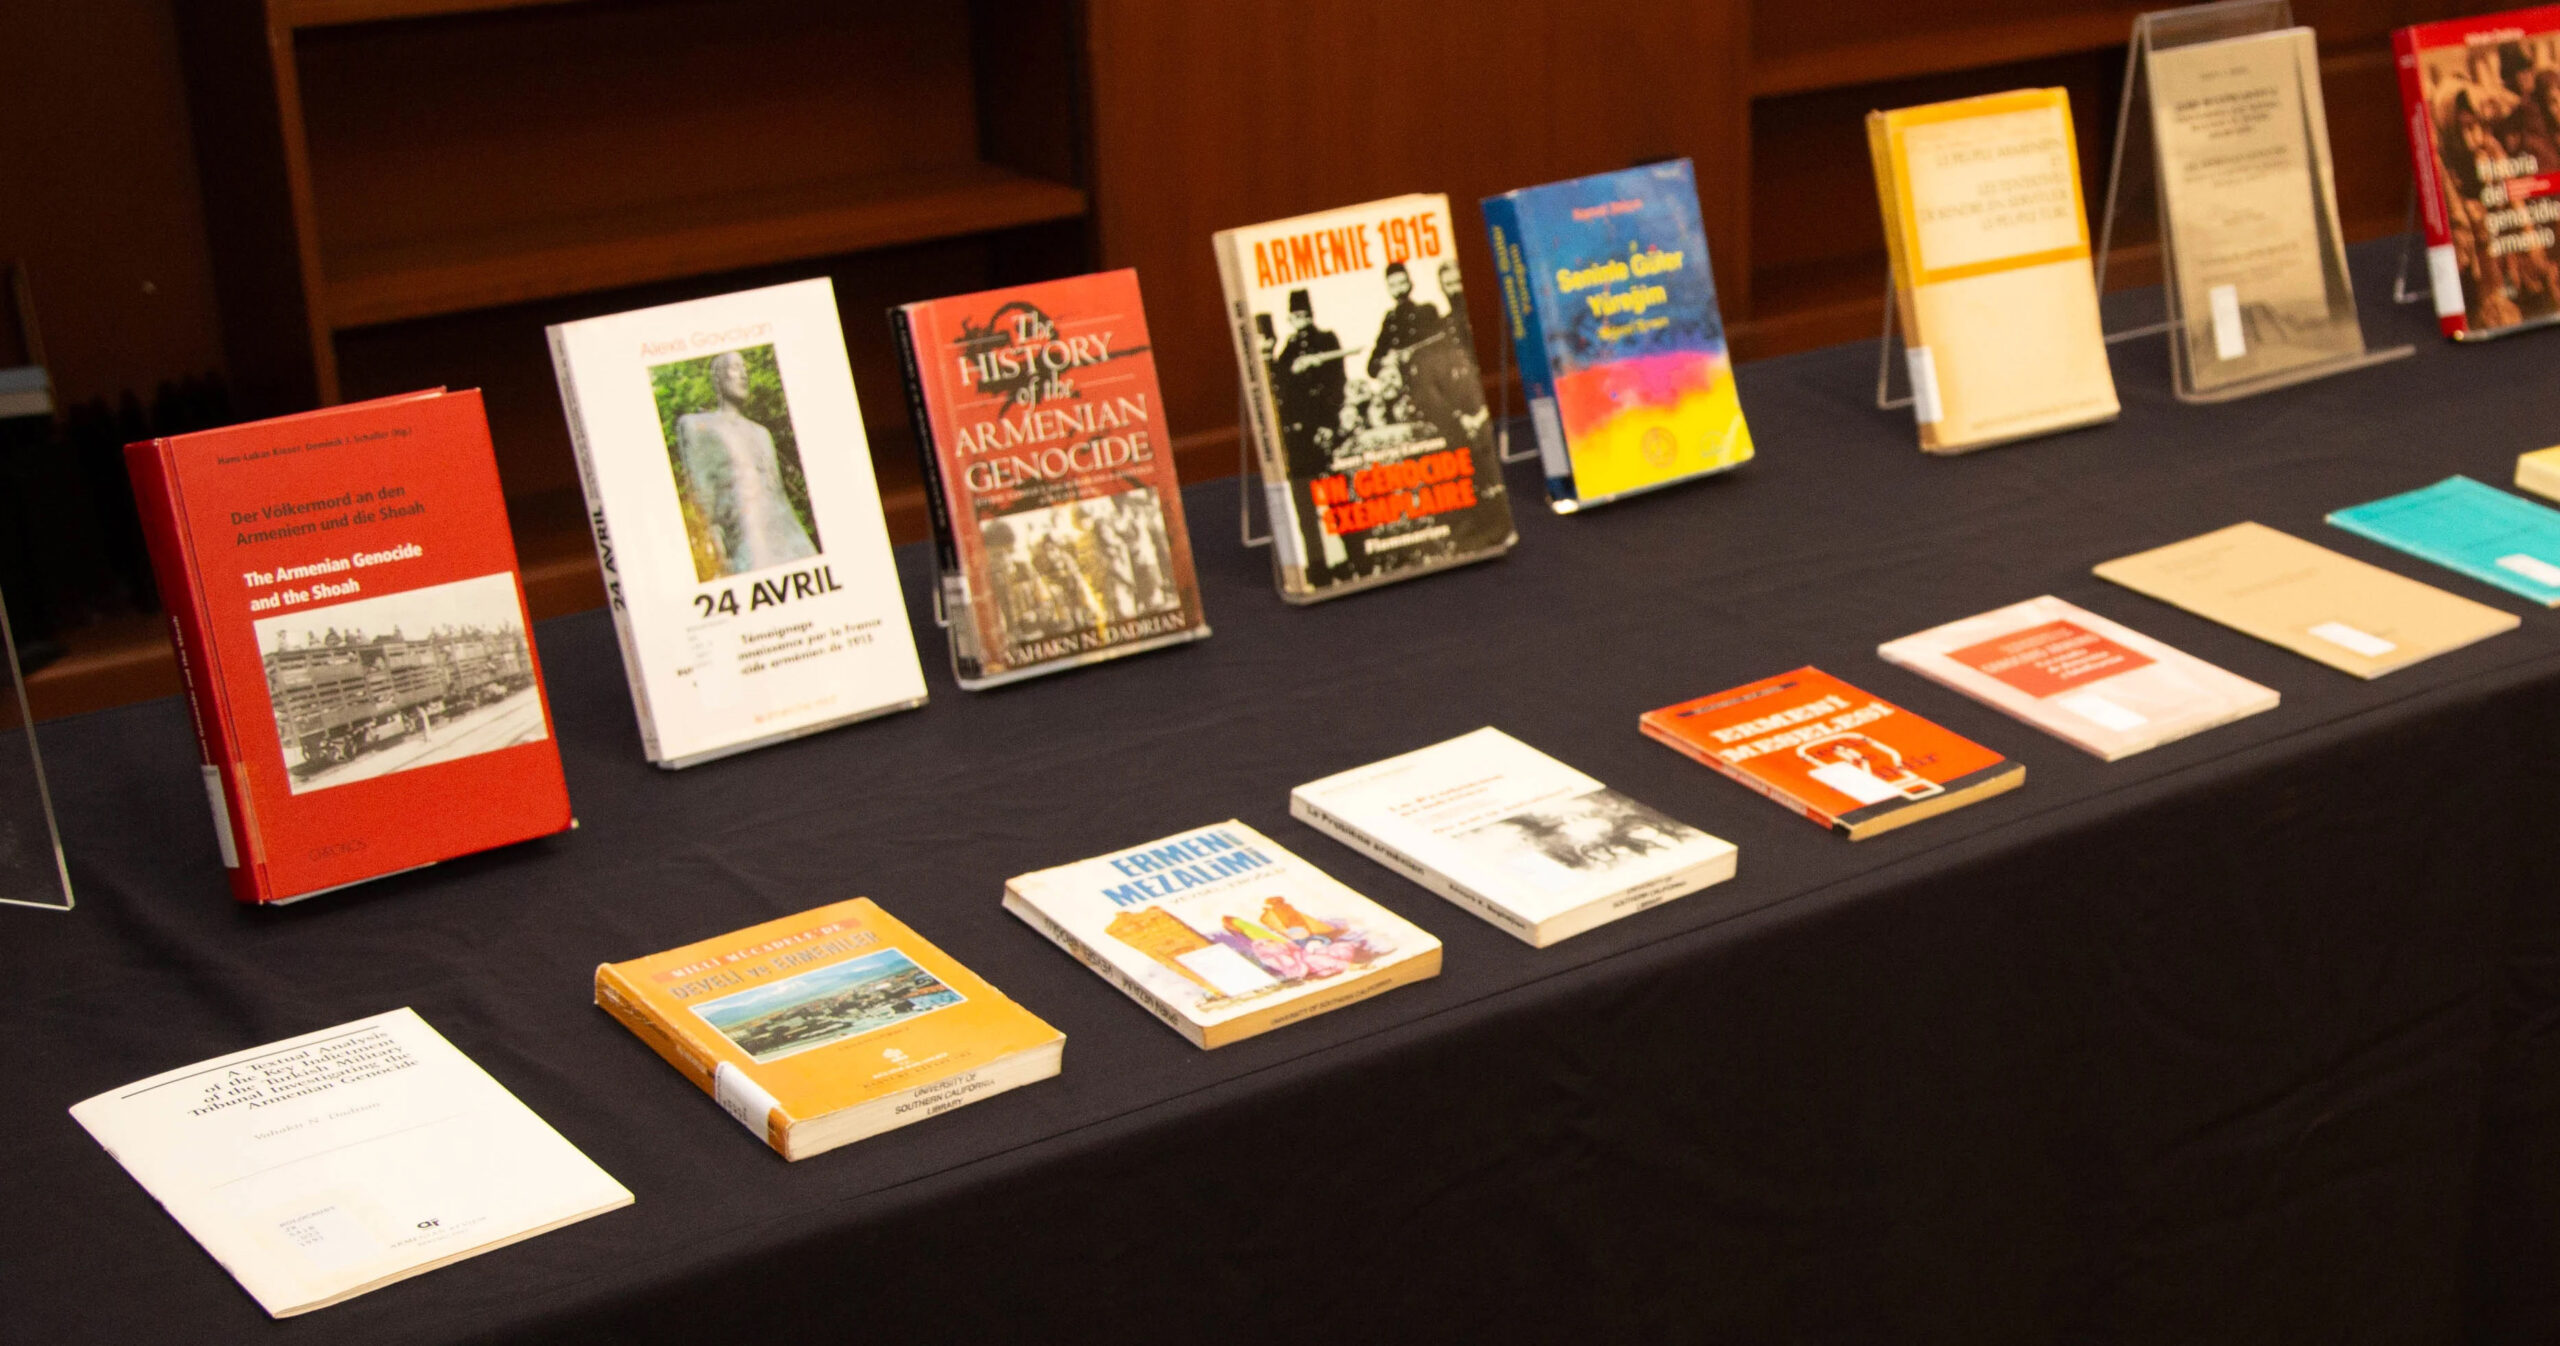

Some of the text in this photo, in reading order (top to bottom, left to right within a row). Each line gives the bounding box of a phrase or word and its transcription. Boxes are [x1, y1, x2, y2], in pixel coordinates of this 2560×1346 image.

[1254, 211, 1442, 289] ARMENIE 1915
[2489, 226, 2555, 258] armenio
[1012, 310, 1055, 344] The
[958, 331, 1114, 387] HISTORY
[1017, 372, 1075, 411] of the
[954, 393, 1150, 458] ARMENIAN
[963, 430, 1155, 492] GENOCIDE
[230, 485, 406, 526] Der Völkermord an den
[235, 501, 426, 547] Armeniern und die Shoah
[243, 542, 424, 588] The Armenian Genocide
[592, 504, 628, 611] 24 AVRIL
[249, 577, 361, 612] and the Shoah
[693, 564, 843, 618] 24 AVRIL
[738, 618, 882, 661] nnaissance par la France
[740, 620, 814, 645] Témoignage
[1005, 635, 1082, 668] VAHAKN
[1104, 611, 1187, 645] DADRIAN
[740, 662, 766, 676] cide
[829, 642, 843, 653] de
[1100, 845, 1275, 907] MEZALİMİ
[1111, 828, 1246, 879] ERMENİ
[745, 965, 773, 978] ve
[203, 1045, 404, 1105] of the Turkish Military
[204, 1038, 396, 1094] of the Key Indictment
[227, 1031, 389, 1079] A Textual Analysis
[186, 1052, 413, 1117] Tribunal Investigating the
[248, 1058, 420, 1111] Armenian Genocide
[895, 1078, 996, 1115] SOUTHERN CALIFORNIA
[913, 1073, 977, 1098] UNIVERSITY OF
[926, 1097, 964, 1116] LIBRARY
